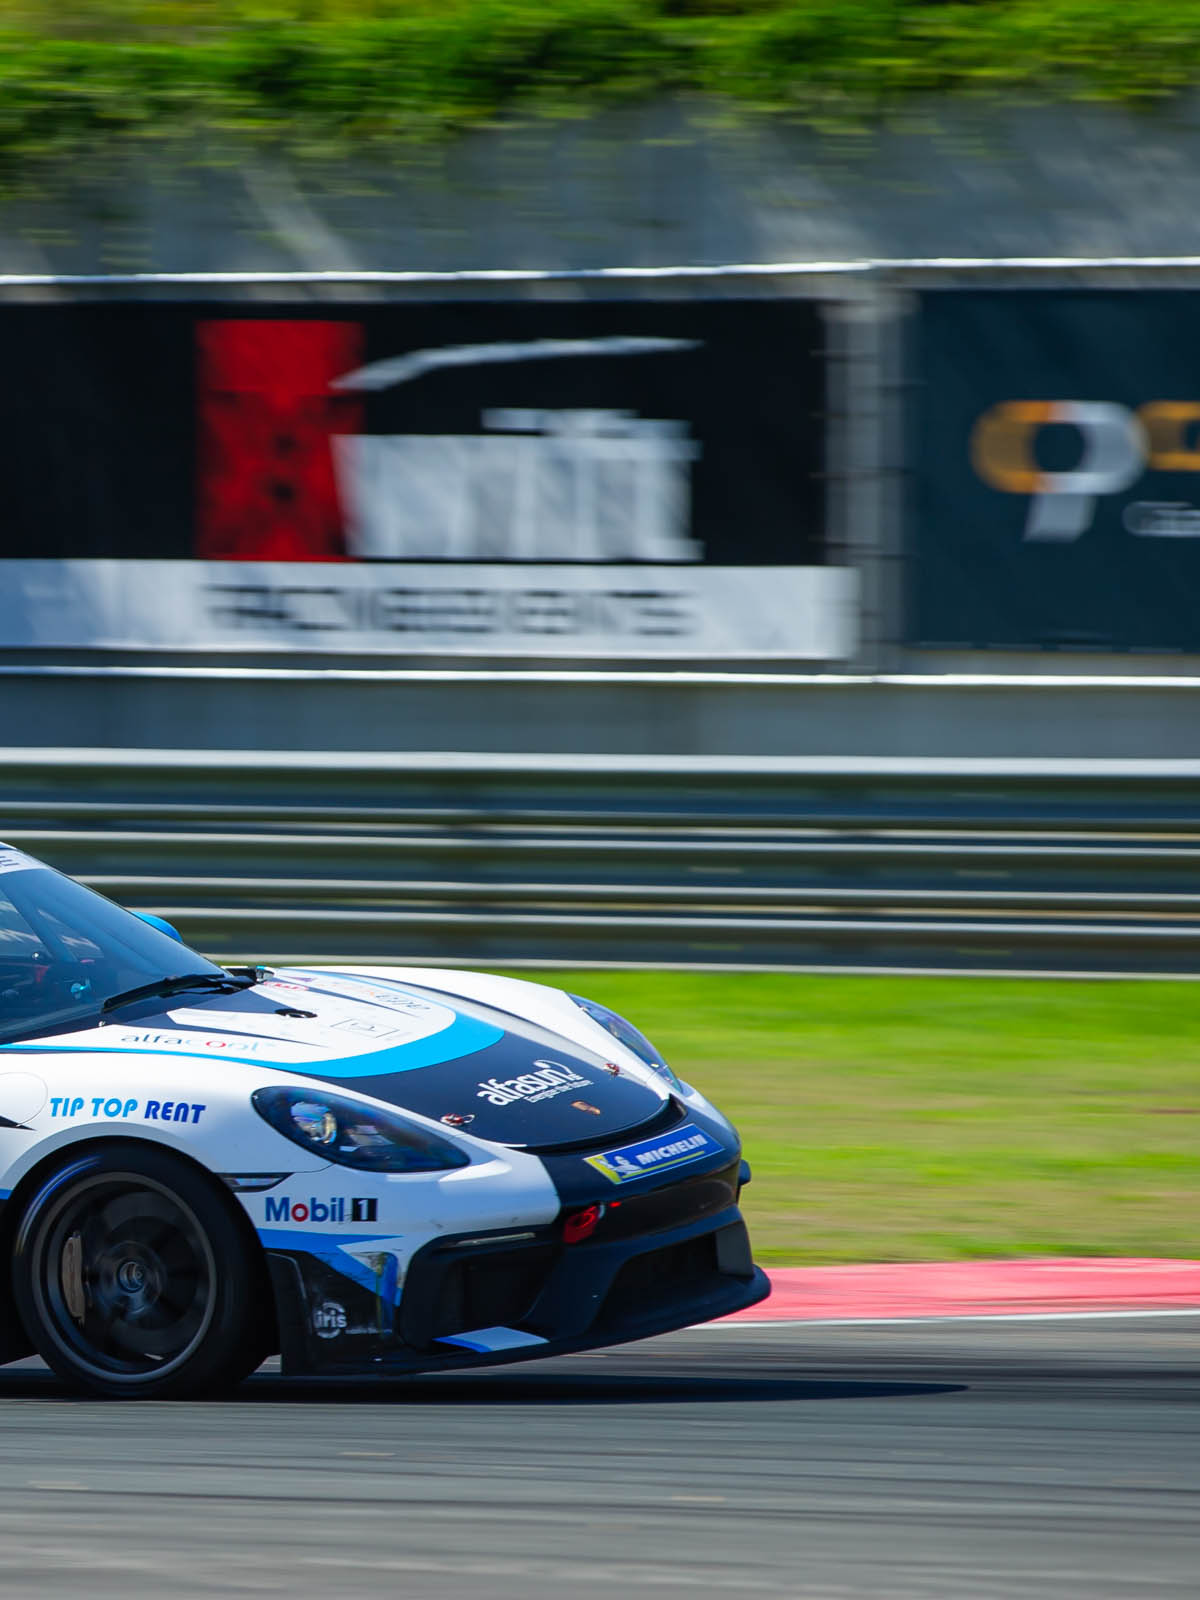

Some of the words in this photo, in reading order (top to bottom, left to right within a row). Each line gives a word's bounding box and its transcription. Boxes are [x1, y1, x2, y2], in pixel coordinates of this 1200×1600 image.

[477, 1059, 584, 1105] alfasun
[50, 1097, 84, 1117] TIP
[91, 1098, 138, 1118] TOP
[144, 1100, 206, 1124] RENT
[636, 1133, 709, 1165] MICHELIN
[265, 1197, 344, 1222] Mobil
[355, 1199, 373, 1221] 1
[314, 1309, 347, 1329] iris
